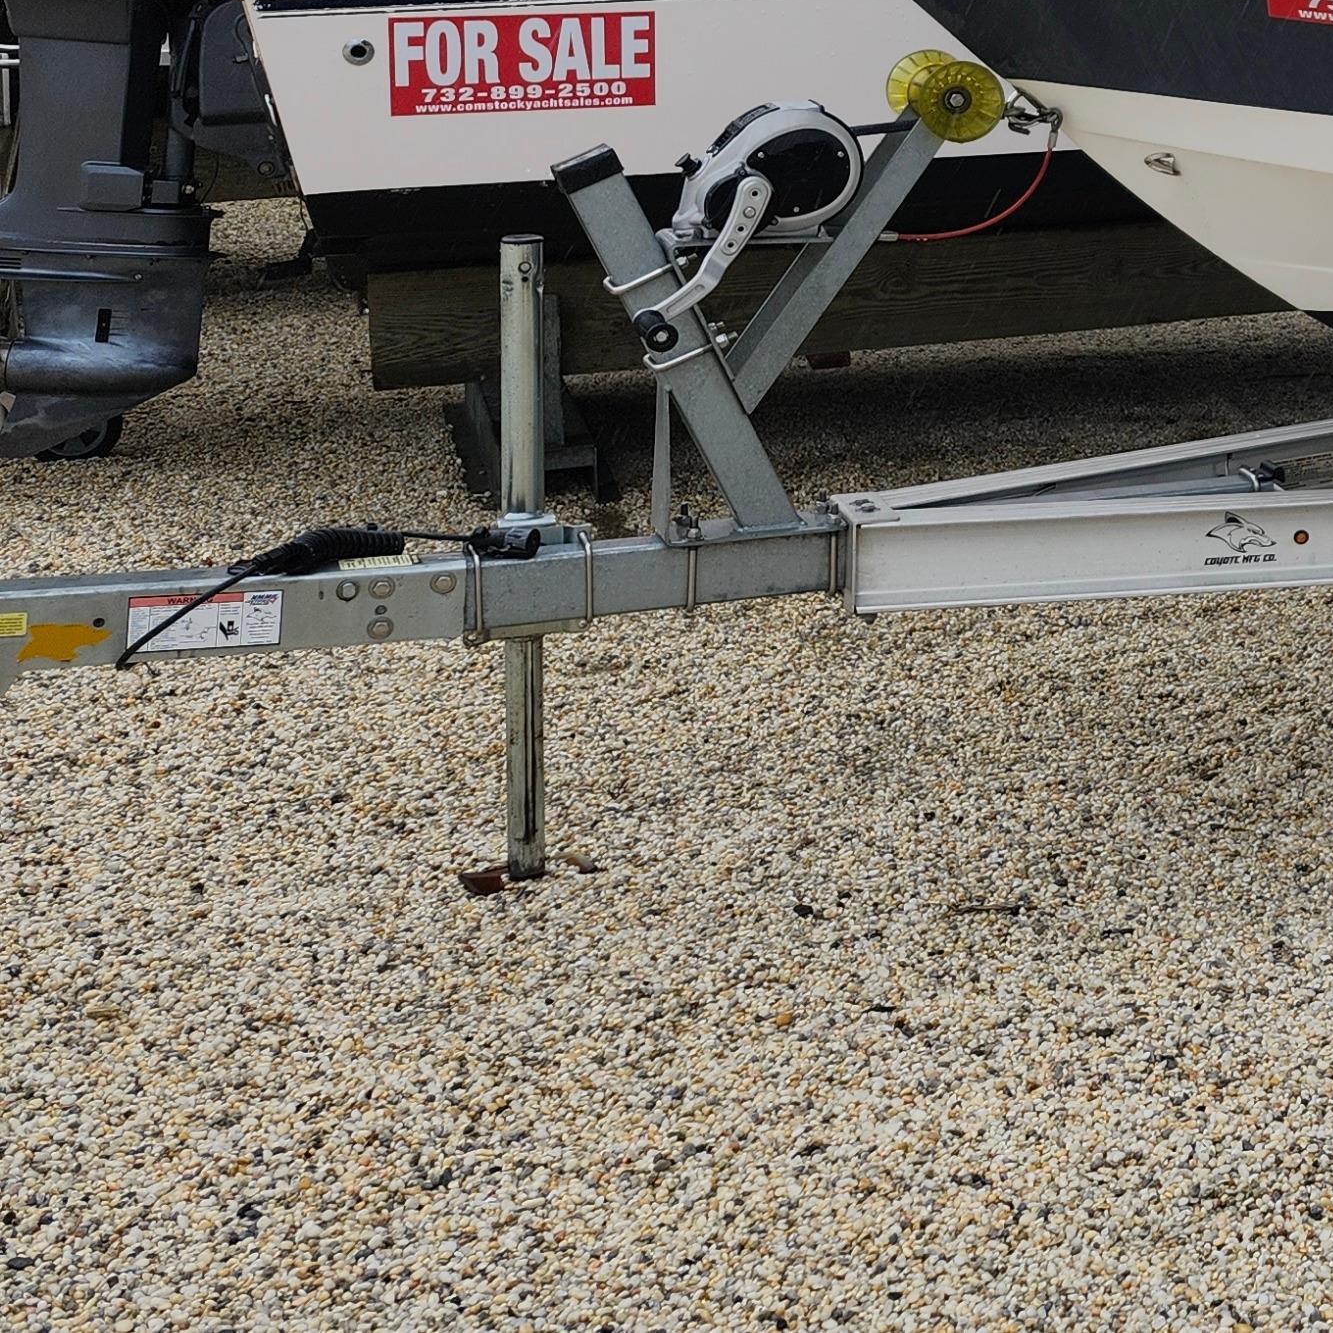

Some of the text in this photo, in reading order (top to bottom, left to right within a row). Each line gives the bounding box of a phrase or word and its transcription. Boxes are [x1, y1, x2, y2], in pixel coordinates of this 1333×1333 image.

[394, 16, 651, 87] FOR SALE
[421, 81, 627, 103] 732-899-2500
[415, 95, 633, 114] www.comstockyachtsales.com
[1204, 555, 1241, 567] COYOTE
[1242, 554, 1262, 563] MFG
